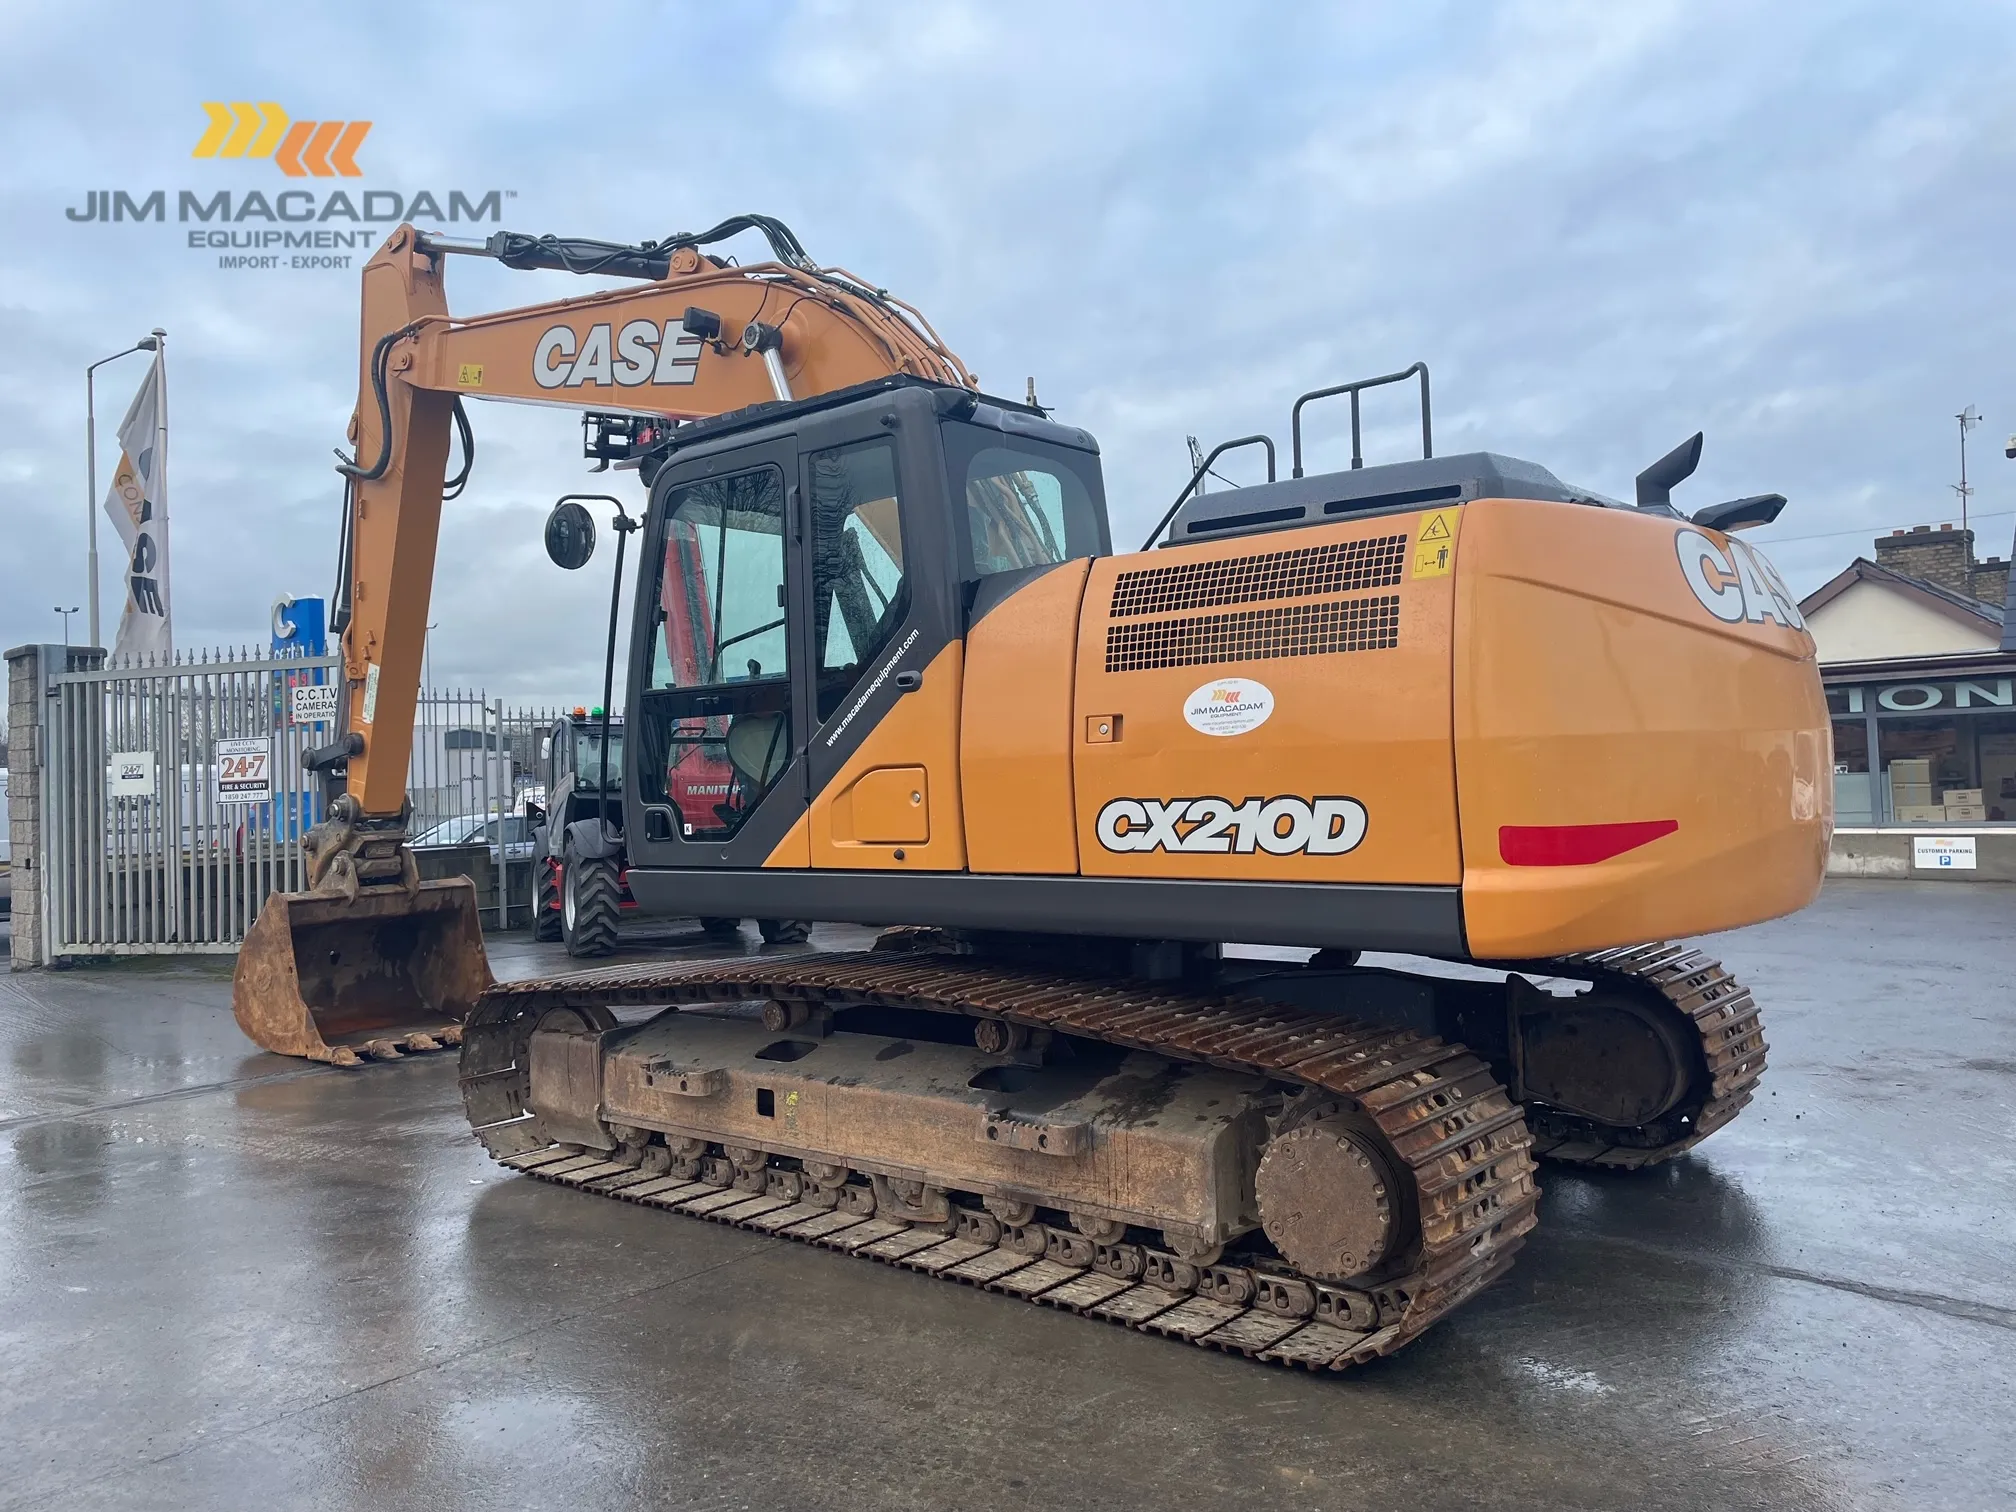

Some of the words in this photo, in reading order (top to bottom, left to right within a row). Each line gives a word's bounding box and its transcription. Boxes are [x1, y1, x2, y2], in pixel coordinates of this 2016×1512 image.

[532, 318, 703, 389] CASE
[826, 628, 919, 747] www.macadamequipment.com
[1191, 707, 1208, 716] JIM
[1209, 702, 1263, 713] MACADAM
[1826, 679, 2013, 713] ION
[1094, 794, 1369, 856] CX210D
